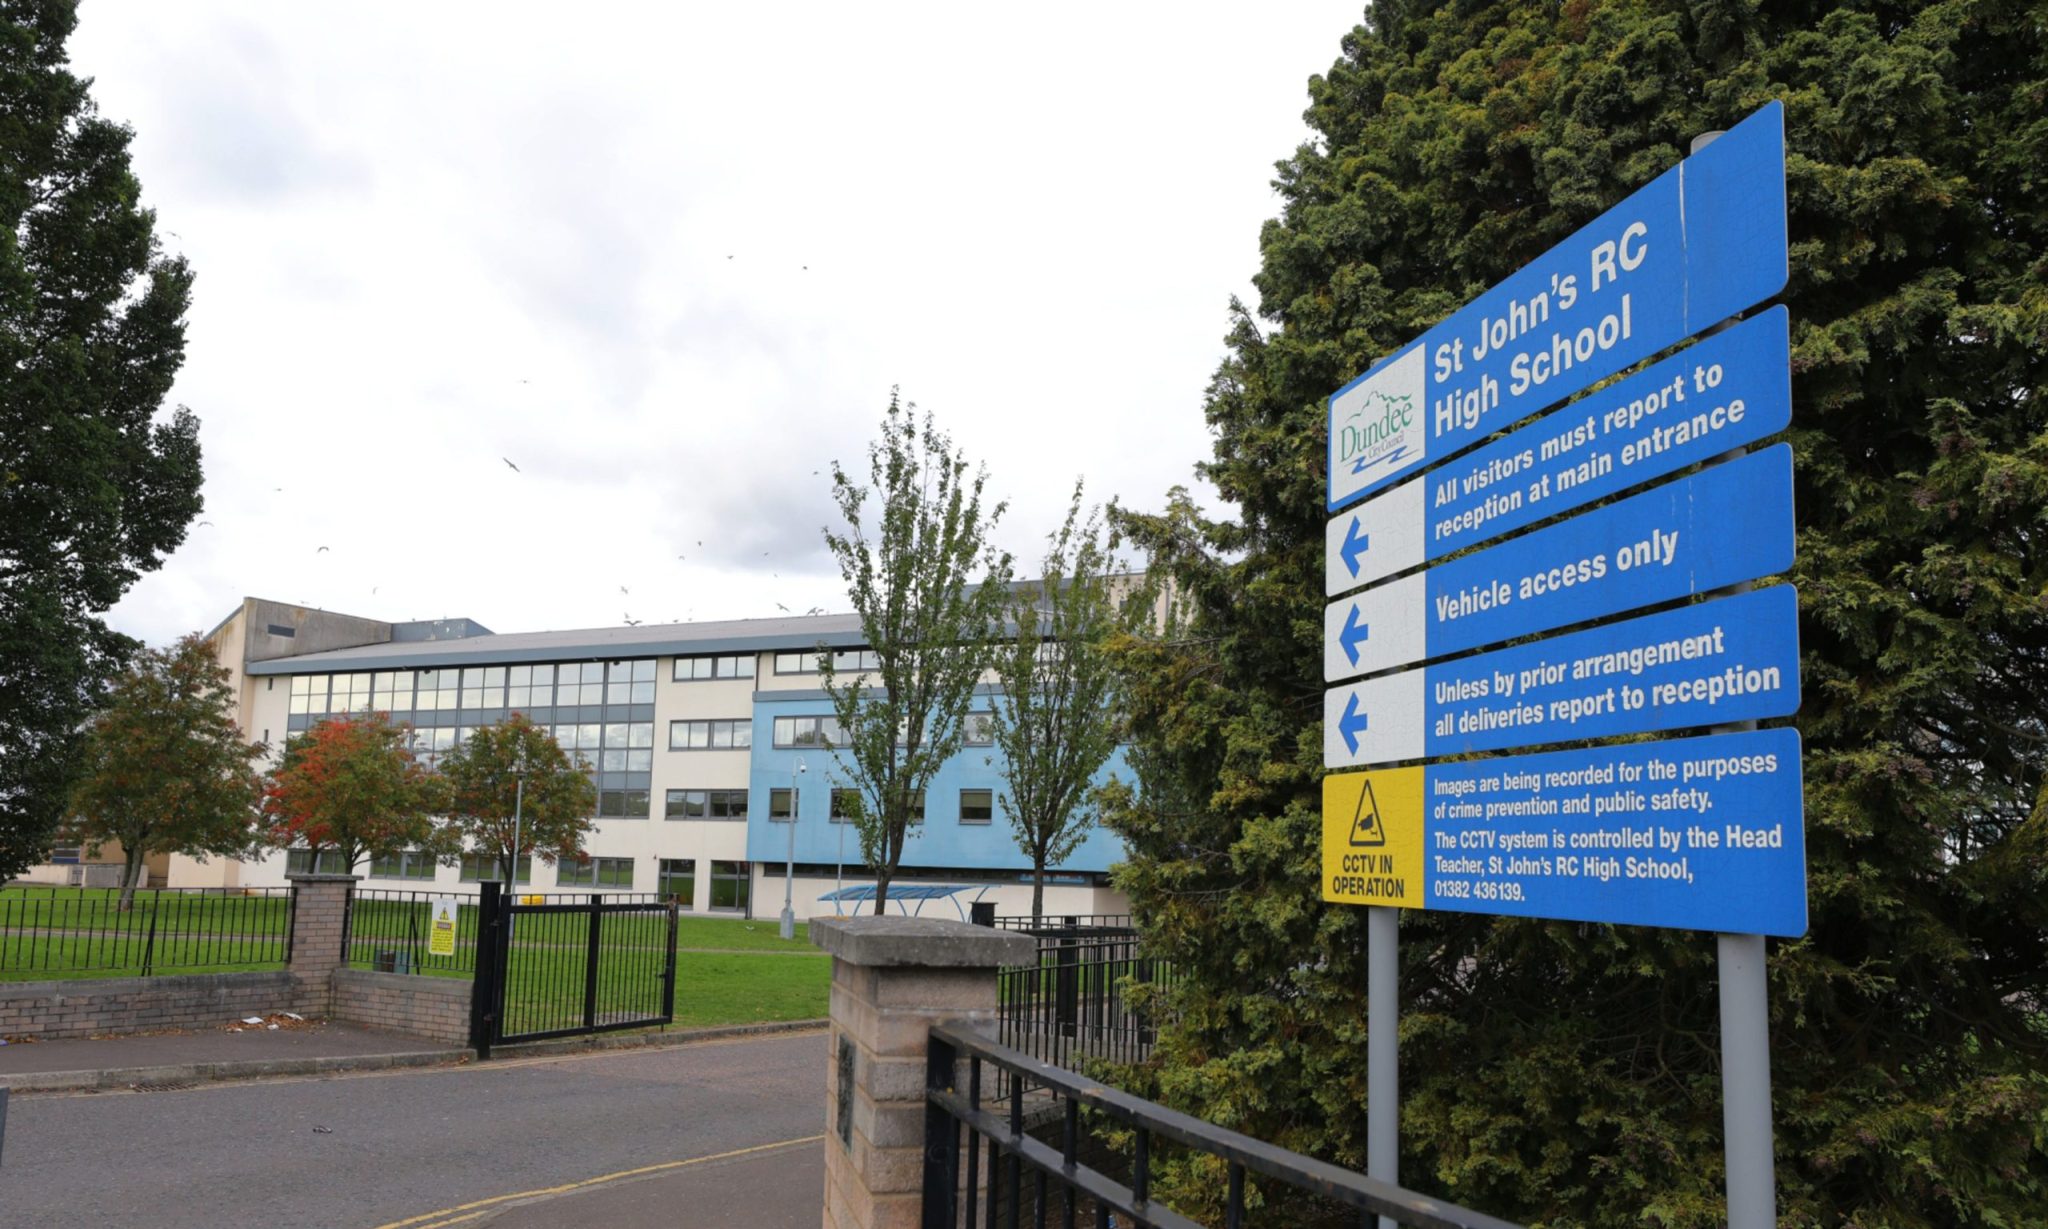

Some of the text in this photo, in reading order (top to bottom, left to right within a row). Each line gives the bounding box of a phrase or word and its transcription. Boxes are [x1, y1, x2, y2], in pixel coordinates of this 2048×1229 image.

[1435, 222, 1647, 382] St John's RC
[1435, 294, 1630, 437] High School
[1341, 402, 1413, 462] Dundee
[1436, 365, 1722, 507] All visitors must report to
[1435, 400, 1744, 540] reception at main entrance
[1436, 529, 1678, 622] Vehicle access only
[1436, 627, 1724, 704] Unless by prior arrangement
[1436, 667, 1780, 736] all deliveries report to reception
[1435, 755, 1776, 797] Images are being recorded for the purposes
[1435, 788, 1712, 820] of crime prevention and public safety.
[1342, 855, 1393, 875] CCTV IN
[1435, 824, 1781, 852] The CCTV system is controlled by the Head
[1332, 877, 1405, 898] OPERATION
[1435, 856, 1692, 883] Teacher, St John's RC High School,
[1435, 880, 1524, 900] 01382 436139.
